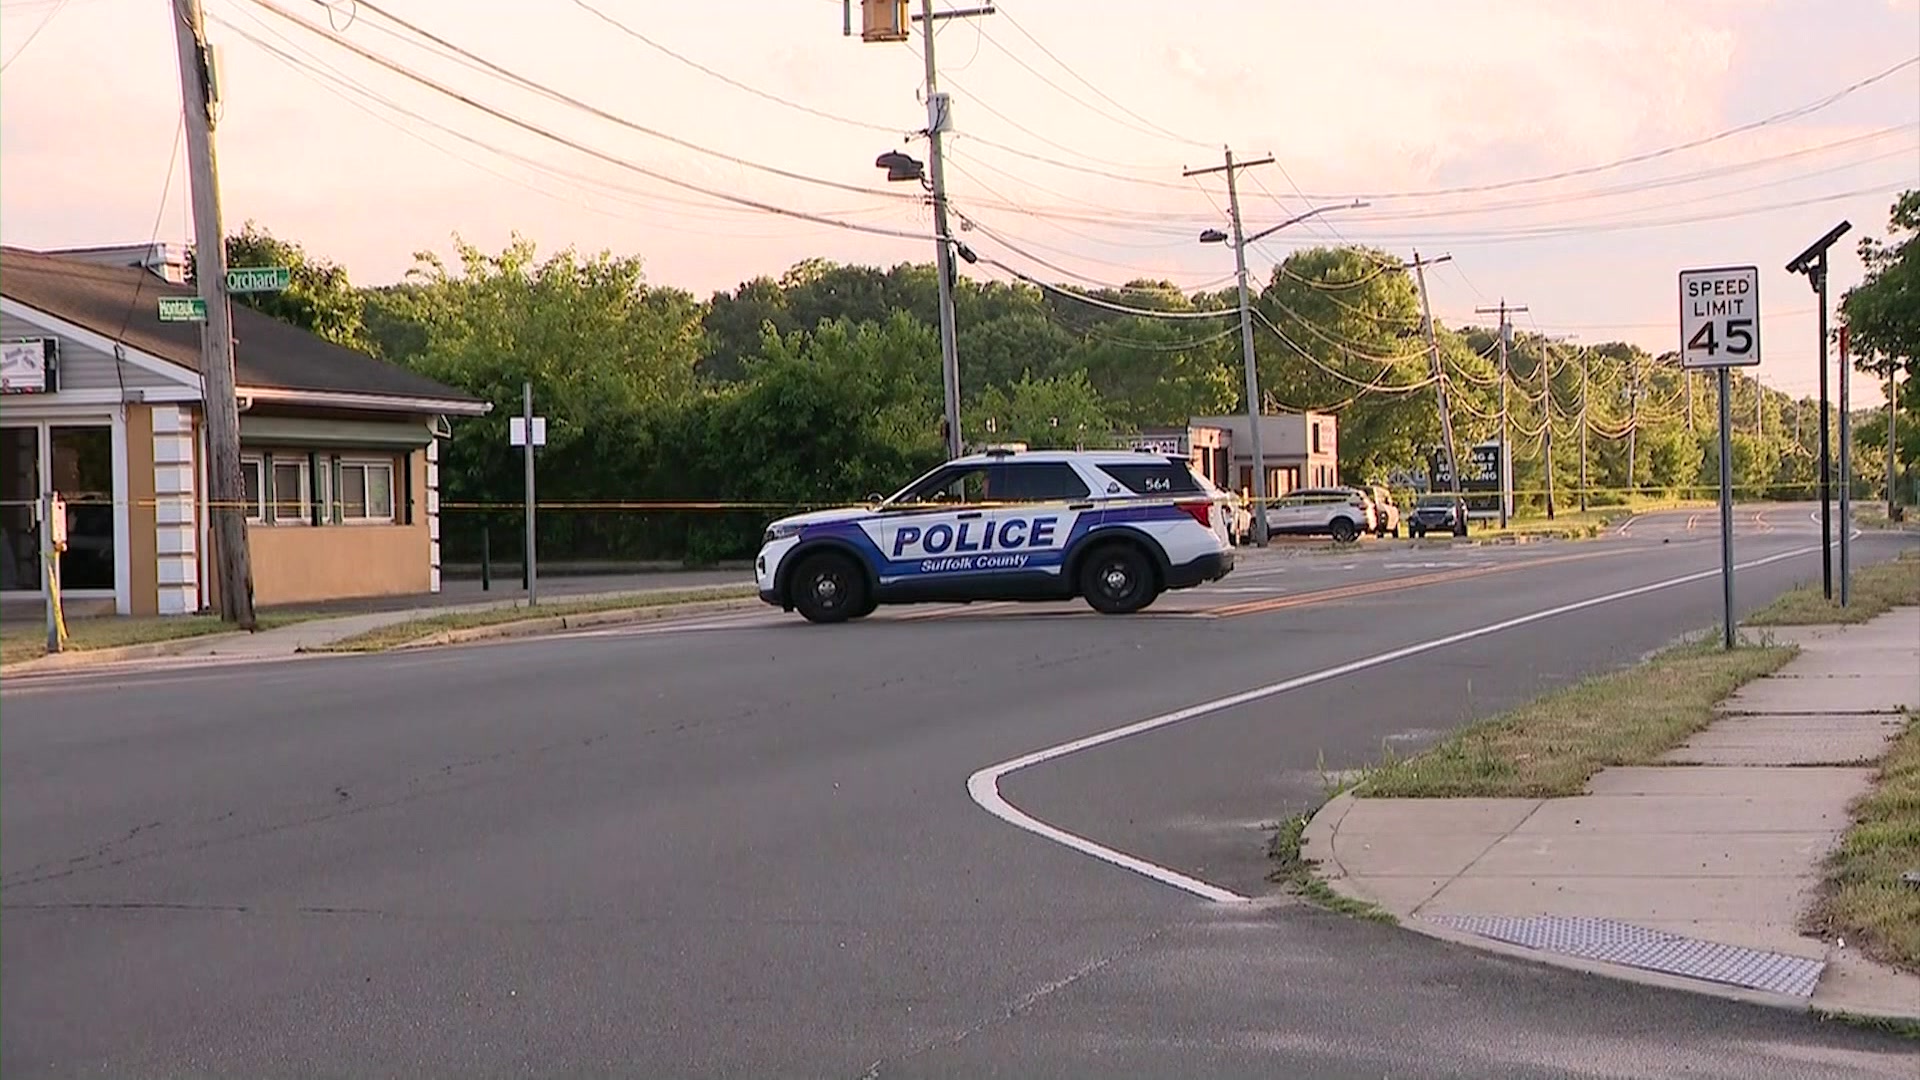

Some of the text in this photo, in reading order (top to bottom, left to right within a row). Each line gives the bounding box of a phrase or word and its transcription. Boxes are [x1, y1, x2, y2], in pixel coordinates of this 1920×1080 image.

[227, 270, 278, 289] Orchard
[1688, 279, 1749, 297] SPEED
[159, 299, 195, 317] Montauk
[1694, 299, 1744, 317] LIMIT
[1687, 319, 1753, 356] 45
[1144, 477, 1171, 492] 564
[892, 516, 1059, 557] POLICE
[920, 554, 1029, 573] Suffolk County
